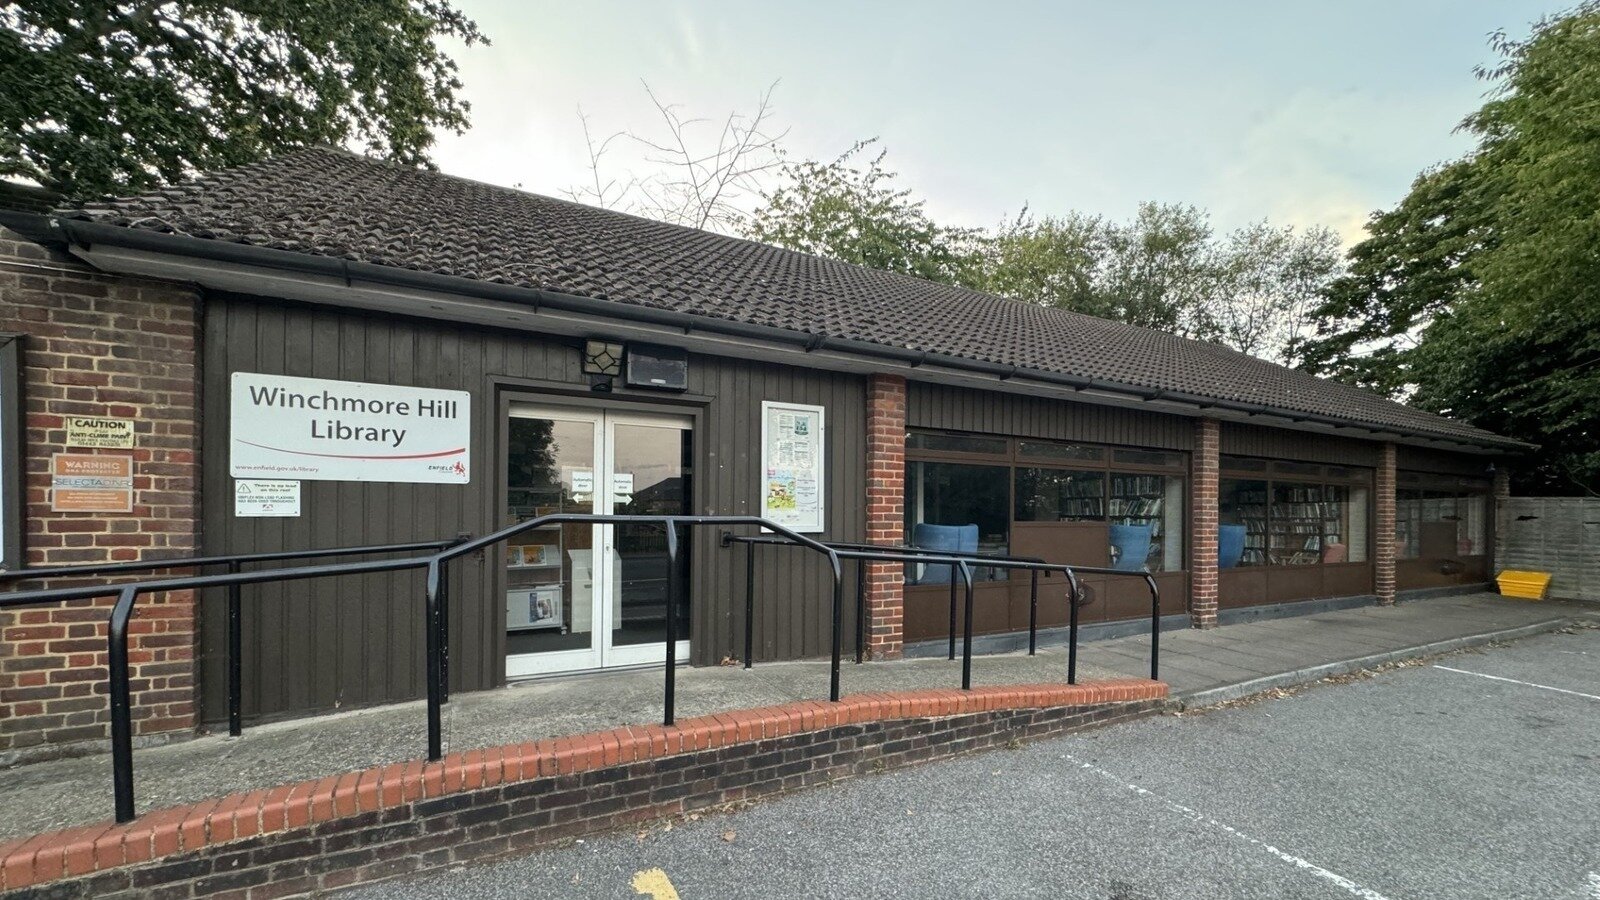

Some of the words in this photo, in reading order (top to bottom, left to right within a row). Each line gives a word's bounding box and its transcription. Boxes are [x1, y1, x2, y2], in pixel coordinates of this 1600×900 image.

[250, 385, 410, 416] Winchmore
[418, 398, 457, 419] Hill
[74, 419, 126, 429] CAUTION
[311, 419, 407, 448] Library
[65, 461, 121, 470] WARNING
[235, 465, 319, 473] www.enfield.gov.uk/library
